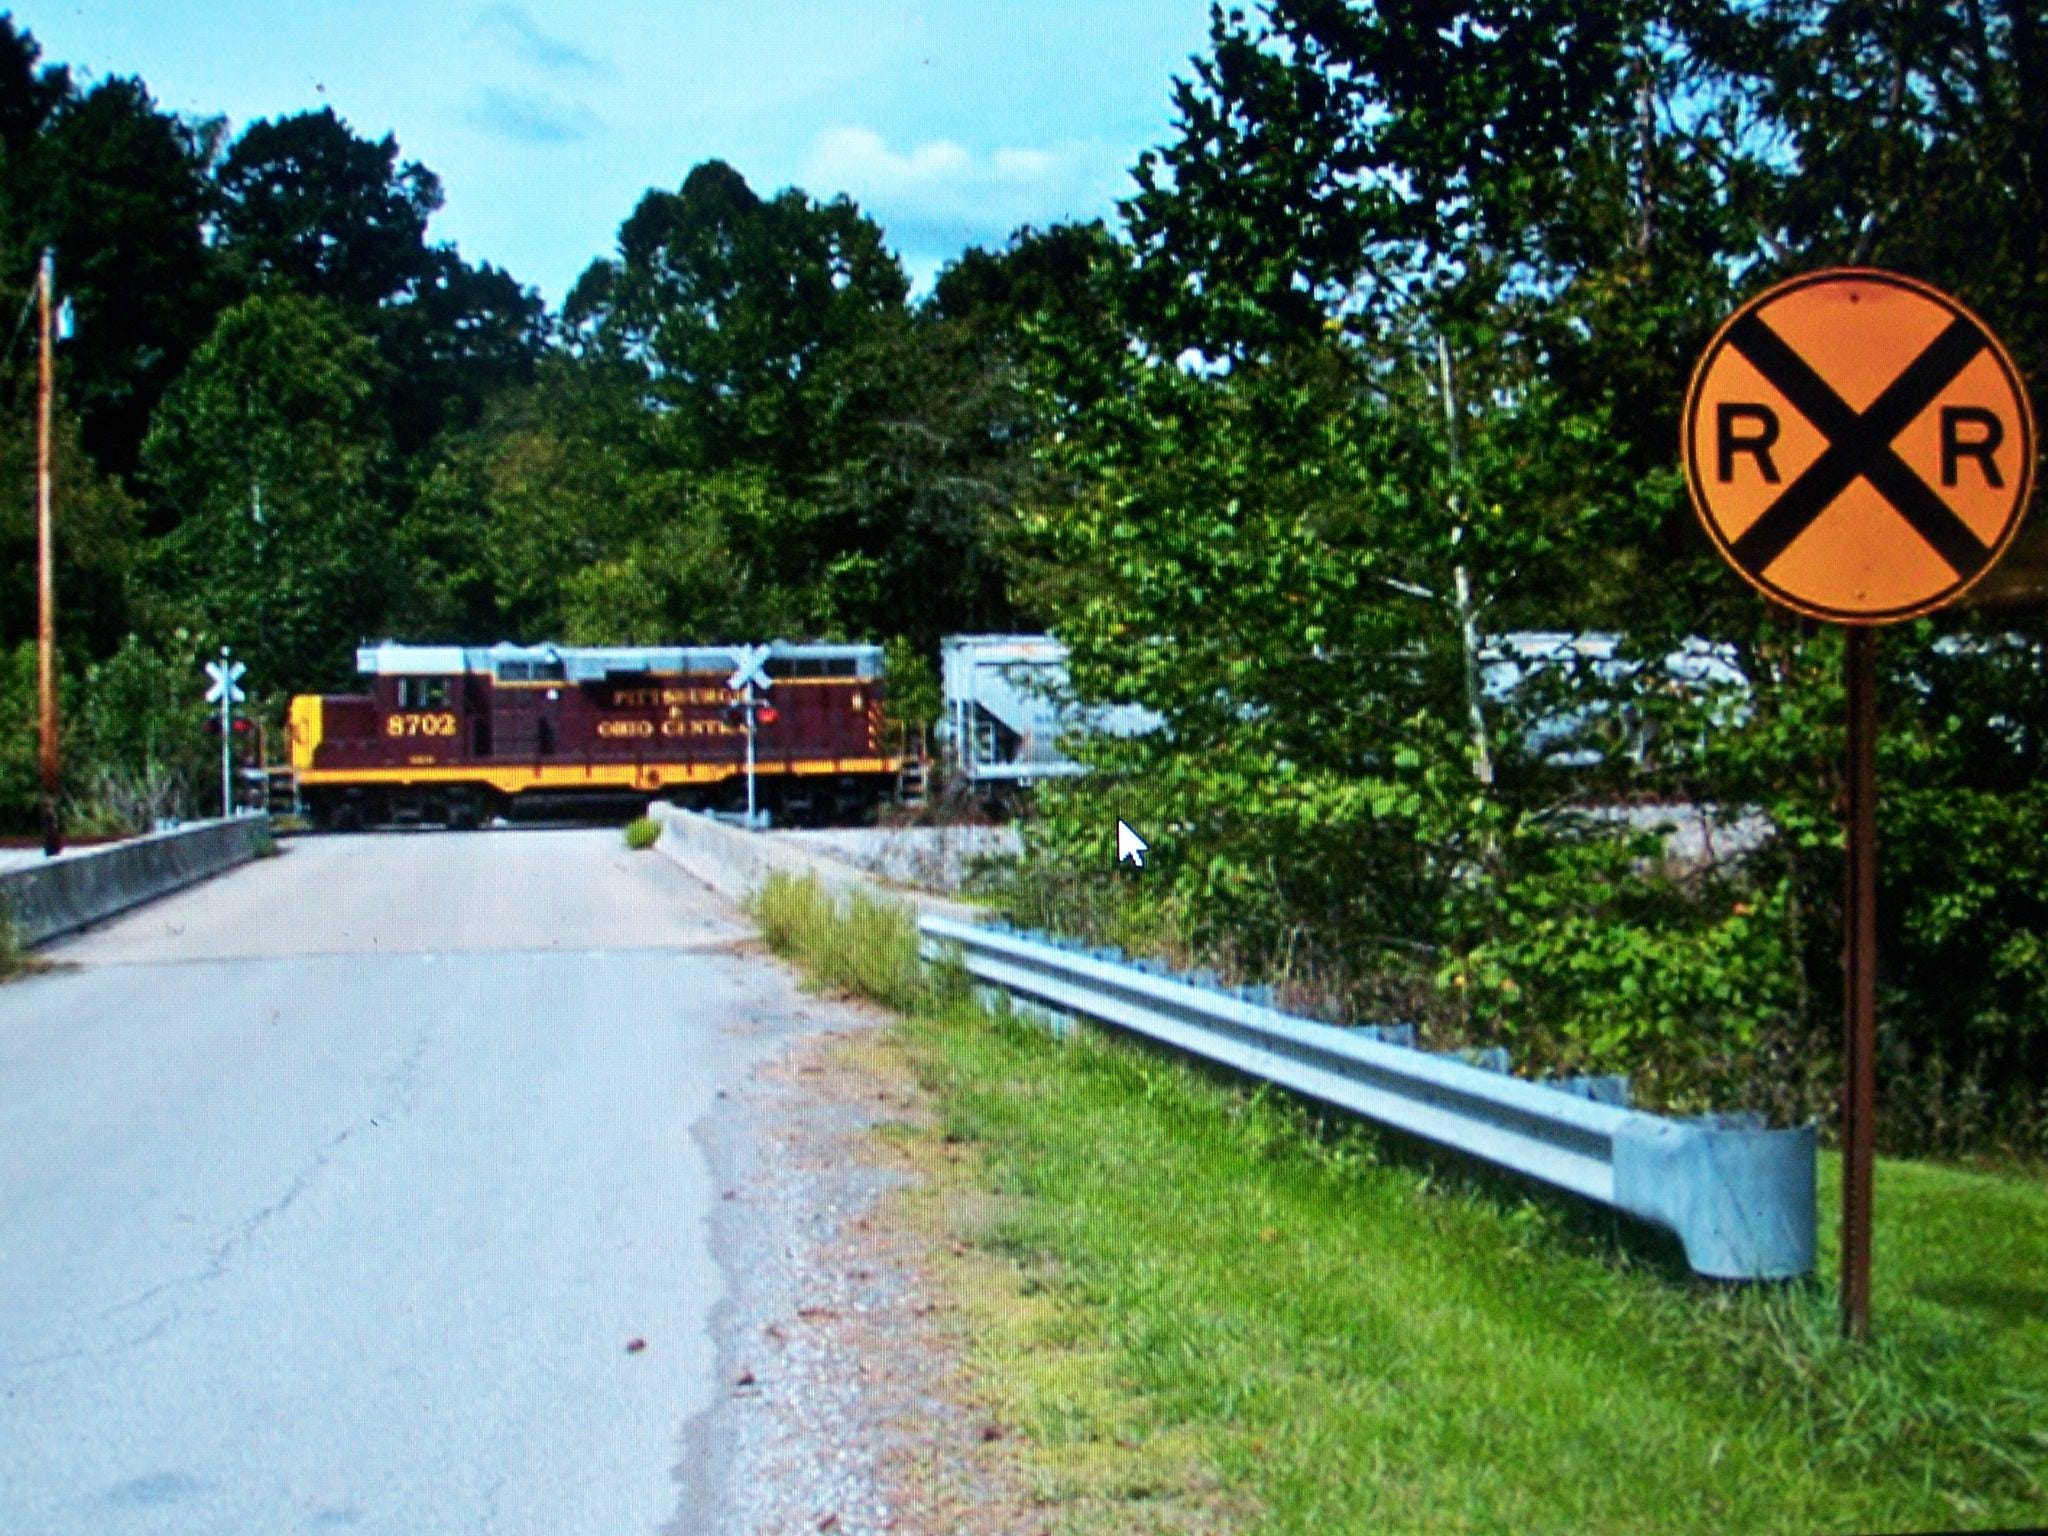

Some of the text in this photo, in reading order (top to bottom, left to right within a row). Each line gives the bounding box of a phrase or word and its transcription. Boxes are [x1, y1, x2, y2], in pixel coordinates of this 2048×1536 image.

[1717, 402, 2005, 488] R R
[386, 712, 456, 737] 8702
[597, 720, 654, 738] OHIO
